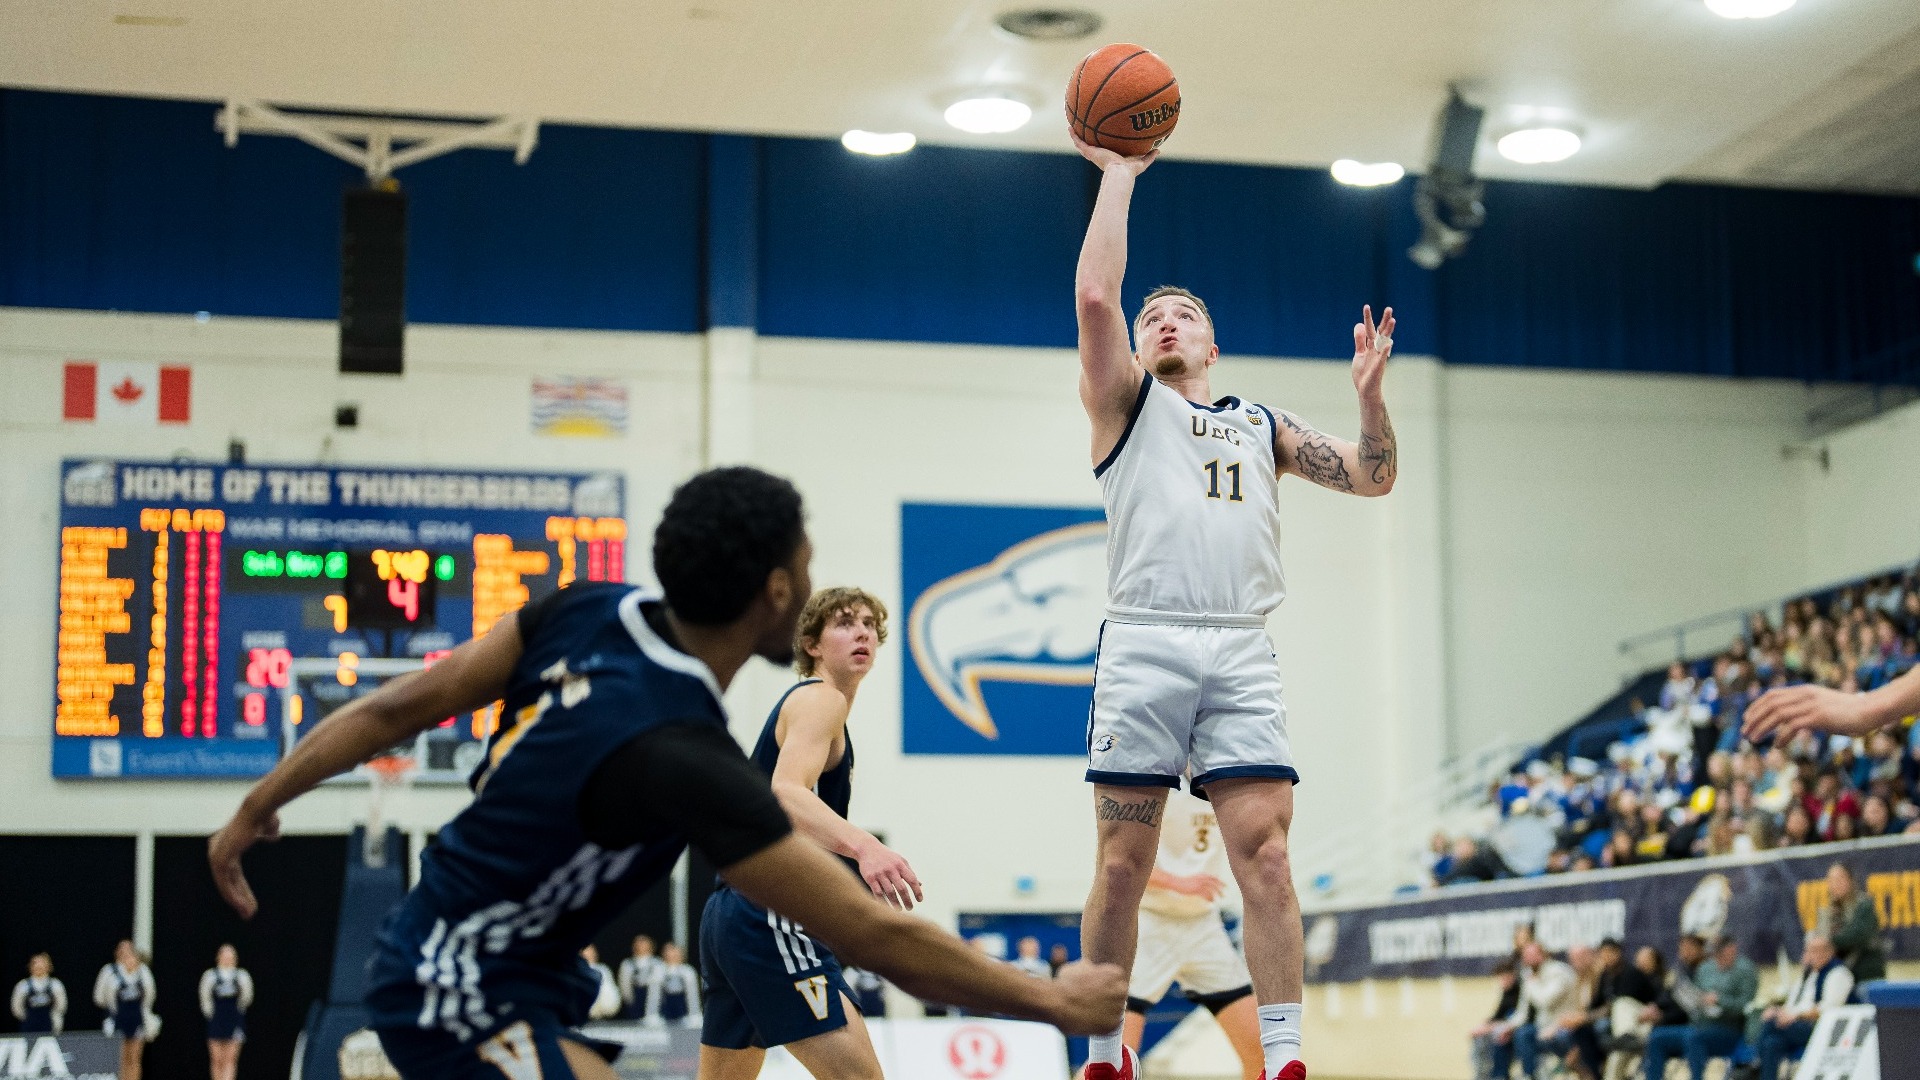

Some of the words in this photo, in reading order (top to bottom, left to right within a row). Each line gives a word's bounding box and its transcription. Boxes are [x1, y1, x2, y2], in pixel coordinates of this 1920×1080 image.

[1129, 97, 1181, 132] Wilso
[122, 467, 214, 501] HOME
[222, 470, 263, 502] OF
[265, 471, 332, 505] THE
[336, 472, 572, 512] THUNDERBIRDS
[1203, 458, 1244, 502] 11
[388, 578, 419, 621] 4
[1194, 827, 1210, 853] 3
[793, 974, 828, 1021] V
[475, 1020, 543, 1080] V
